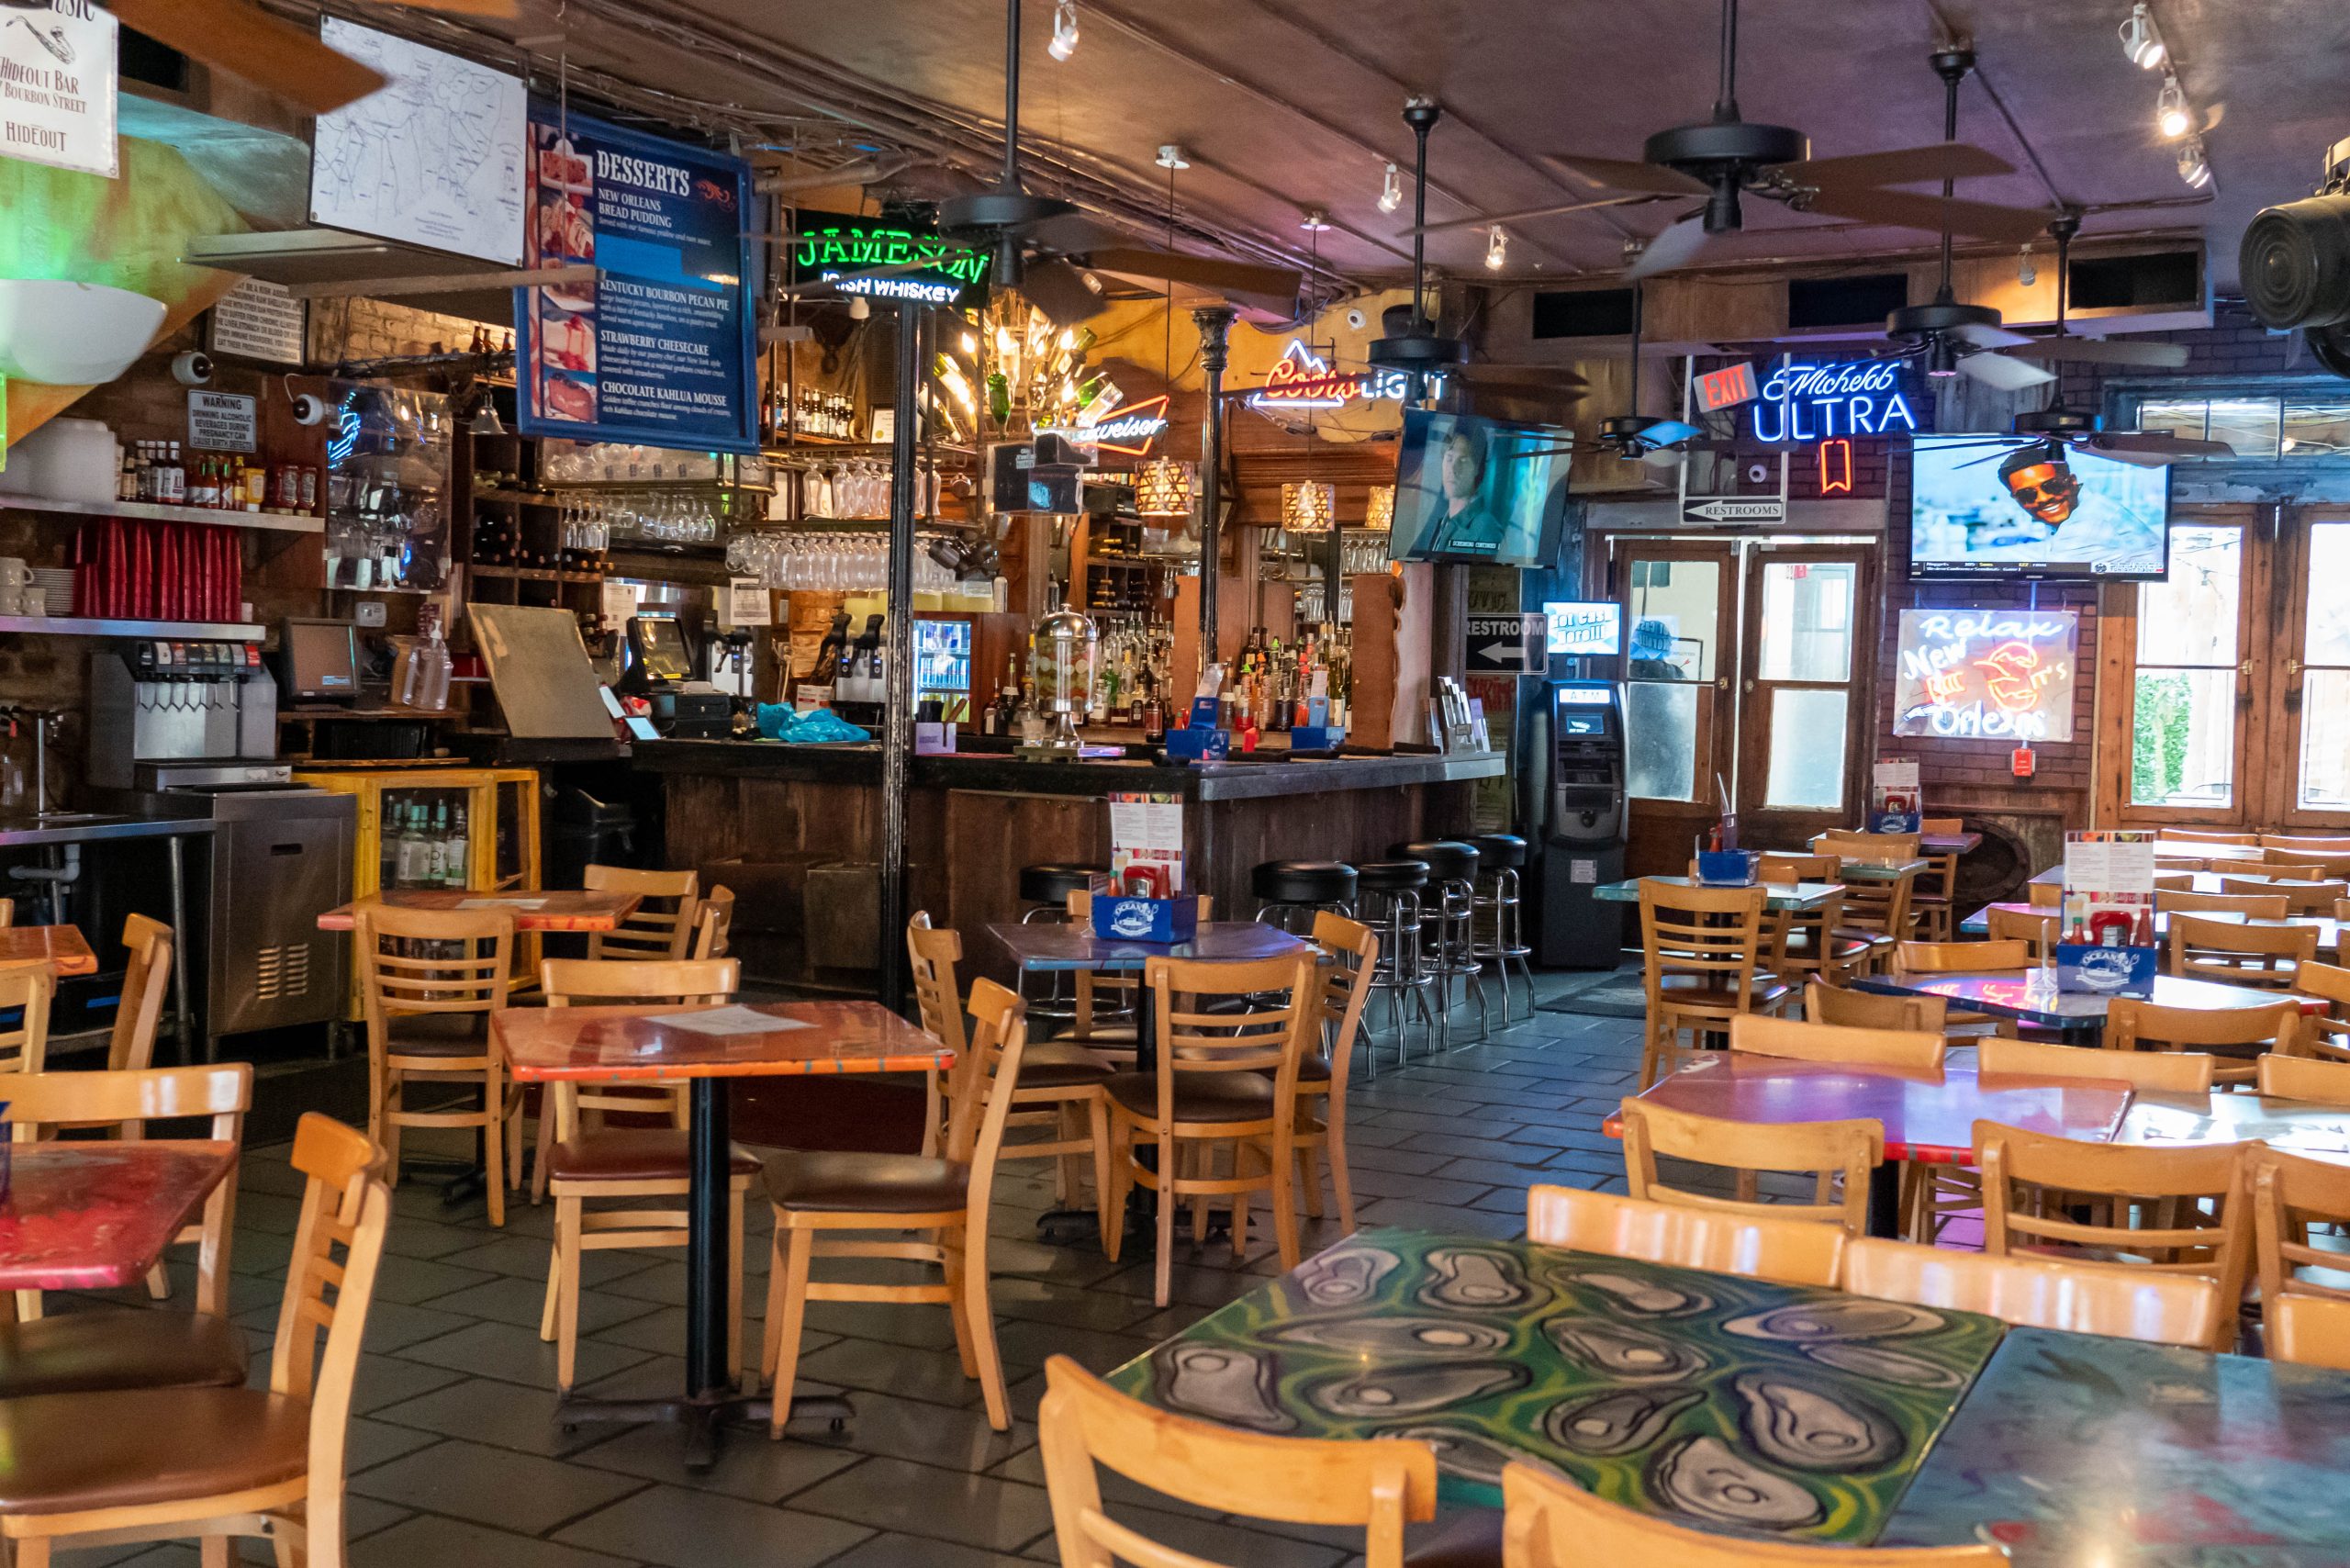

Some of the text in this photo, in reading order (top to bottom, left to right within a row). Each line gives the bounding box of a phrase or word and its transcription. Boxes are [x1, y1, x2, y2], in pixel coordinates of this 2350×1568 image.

[1, 56, 79, 95] HIDEOUT BAR
[5, 82, 86, 114] BOURBON STREET
[6, 120, 67, 151] HIDEOUT
[597, 150, 690, 196] DESSERTS
[599, 187, 661, 212] NEW ORLEANS
[599, 202, 672, 228] BREAD PUDDING
[600, 279, 730, 311] KENTUCKY BOURBON PECAN PIE
[874, 280, 960, 303] WHISKEY
[600, 330, 710, 356] STRAWBERRY CHEESECAKE
[601, 381, 727, 407] CHOCOLATE KAHLUA MOUSSE
[1361, 372, 1448, 399] LIGT
[1703, 364, 1748, 409] EXIT
[1762, 362, 1900, 401] Michelob
[202, 396, 242, 410] WARNING
[1753, 393, 1916, 442] ULTRA
[1705, 505, 1779, 518] RESTROOMS
[1919, 614, 2065, 640] Relax
[1903, 638, 1967, 680] New
[1931, 700, 2050, 738] Orleans
